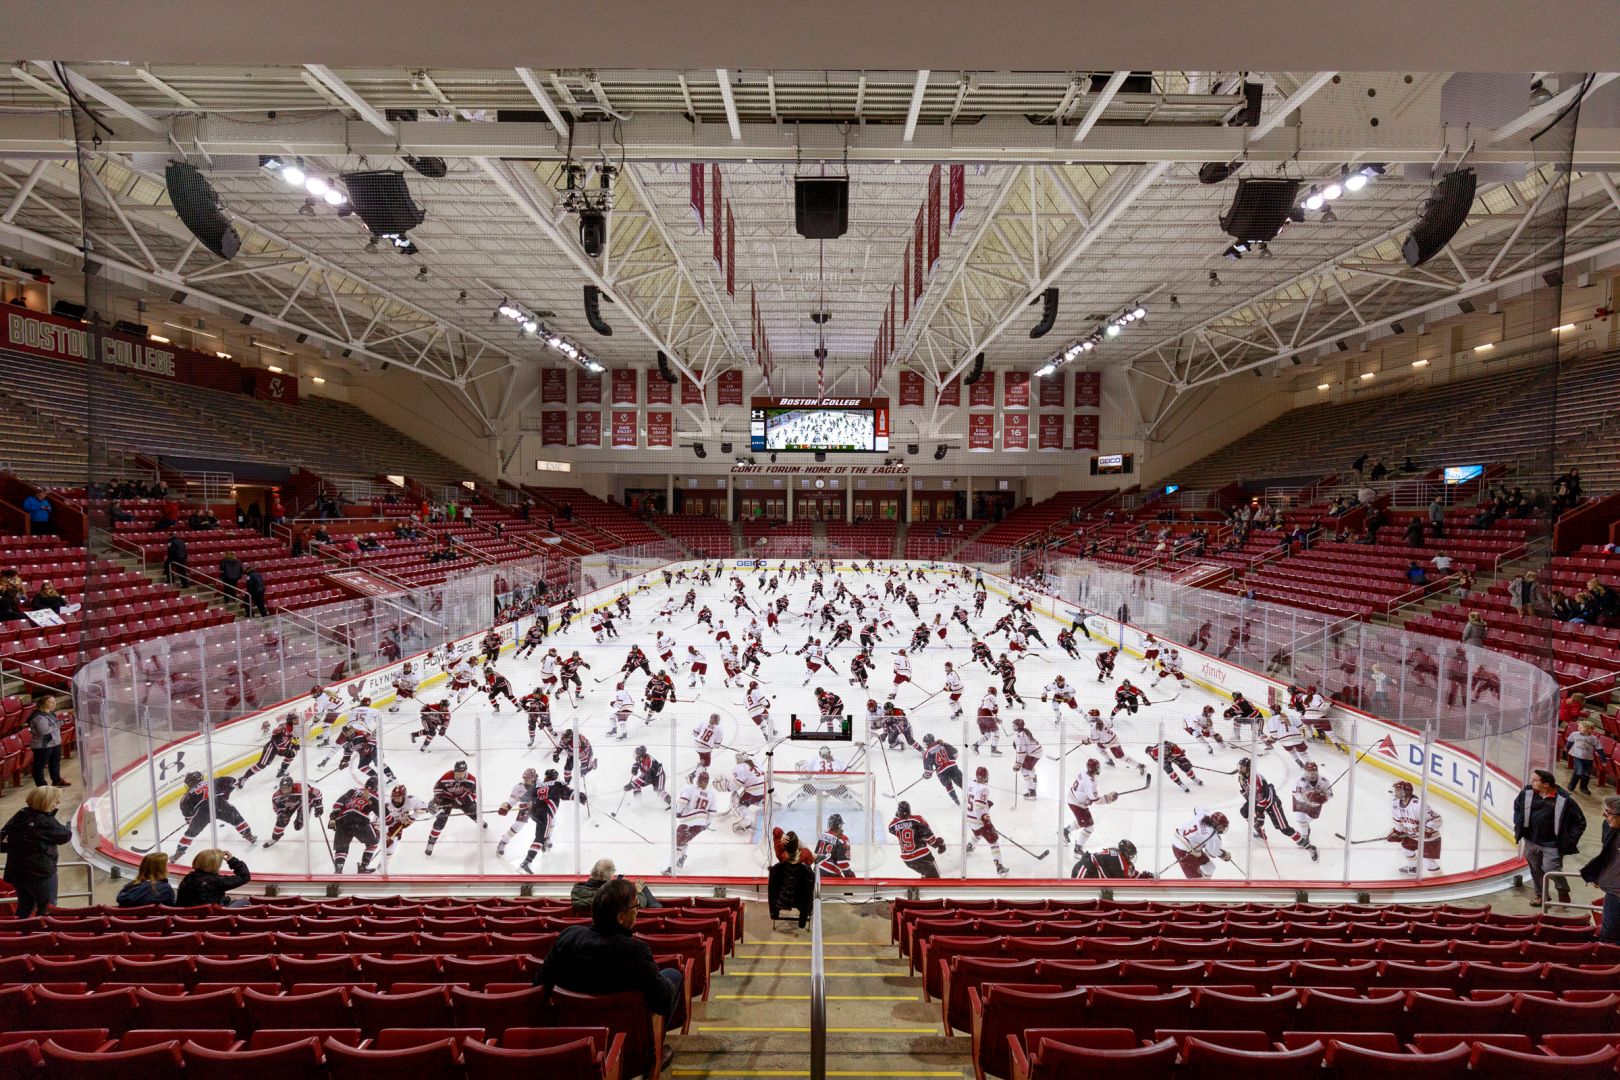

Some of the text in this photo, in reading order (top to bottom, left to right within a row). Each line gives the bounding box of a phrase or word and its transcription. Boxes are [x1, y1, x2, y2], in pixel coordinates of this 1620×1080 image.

[8, 313, 175, 377] BOSTON COLLEGE
[731, 465, 763, 473] CONTE
[872, 466, 910, 474] EAGLES
[1201, 663, 1227, 683] xfinity
[700, 728, 714, 742] 18
[819, 760, 833, 771] 33
[1409, 743, 1494, 807] DELTA
[980, 793, 987, 801] 25
